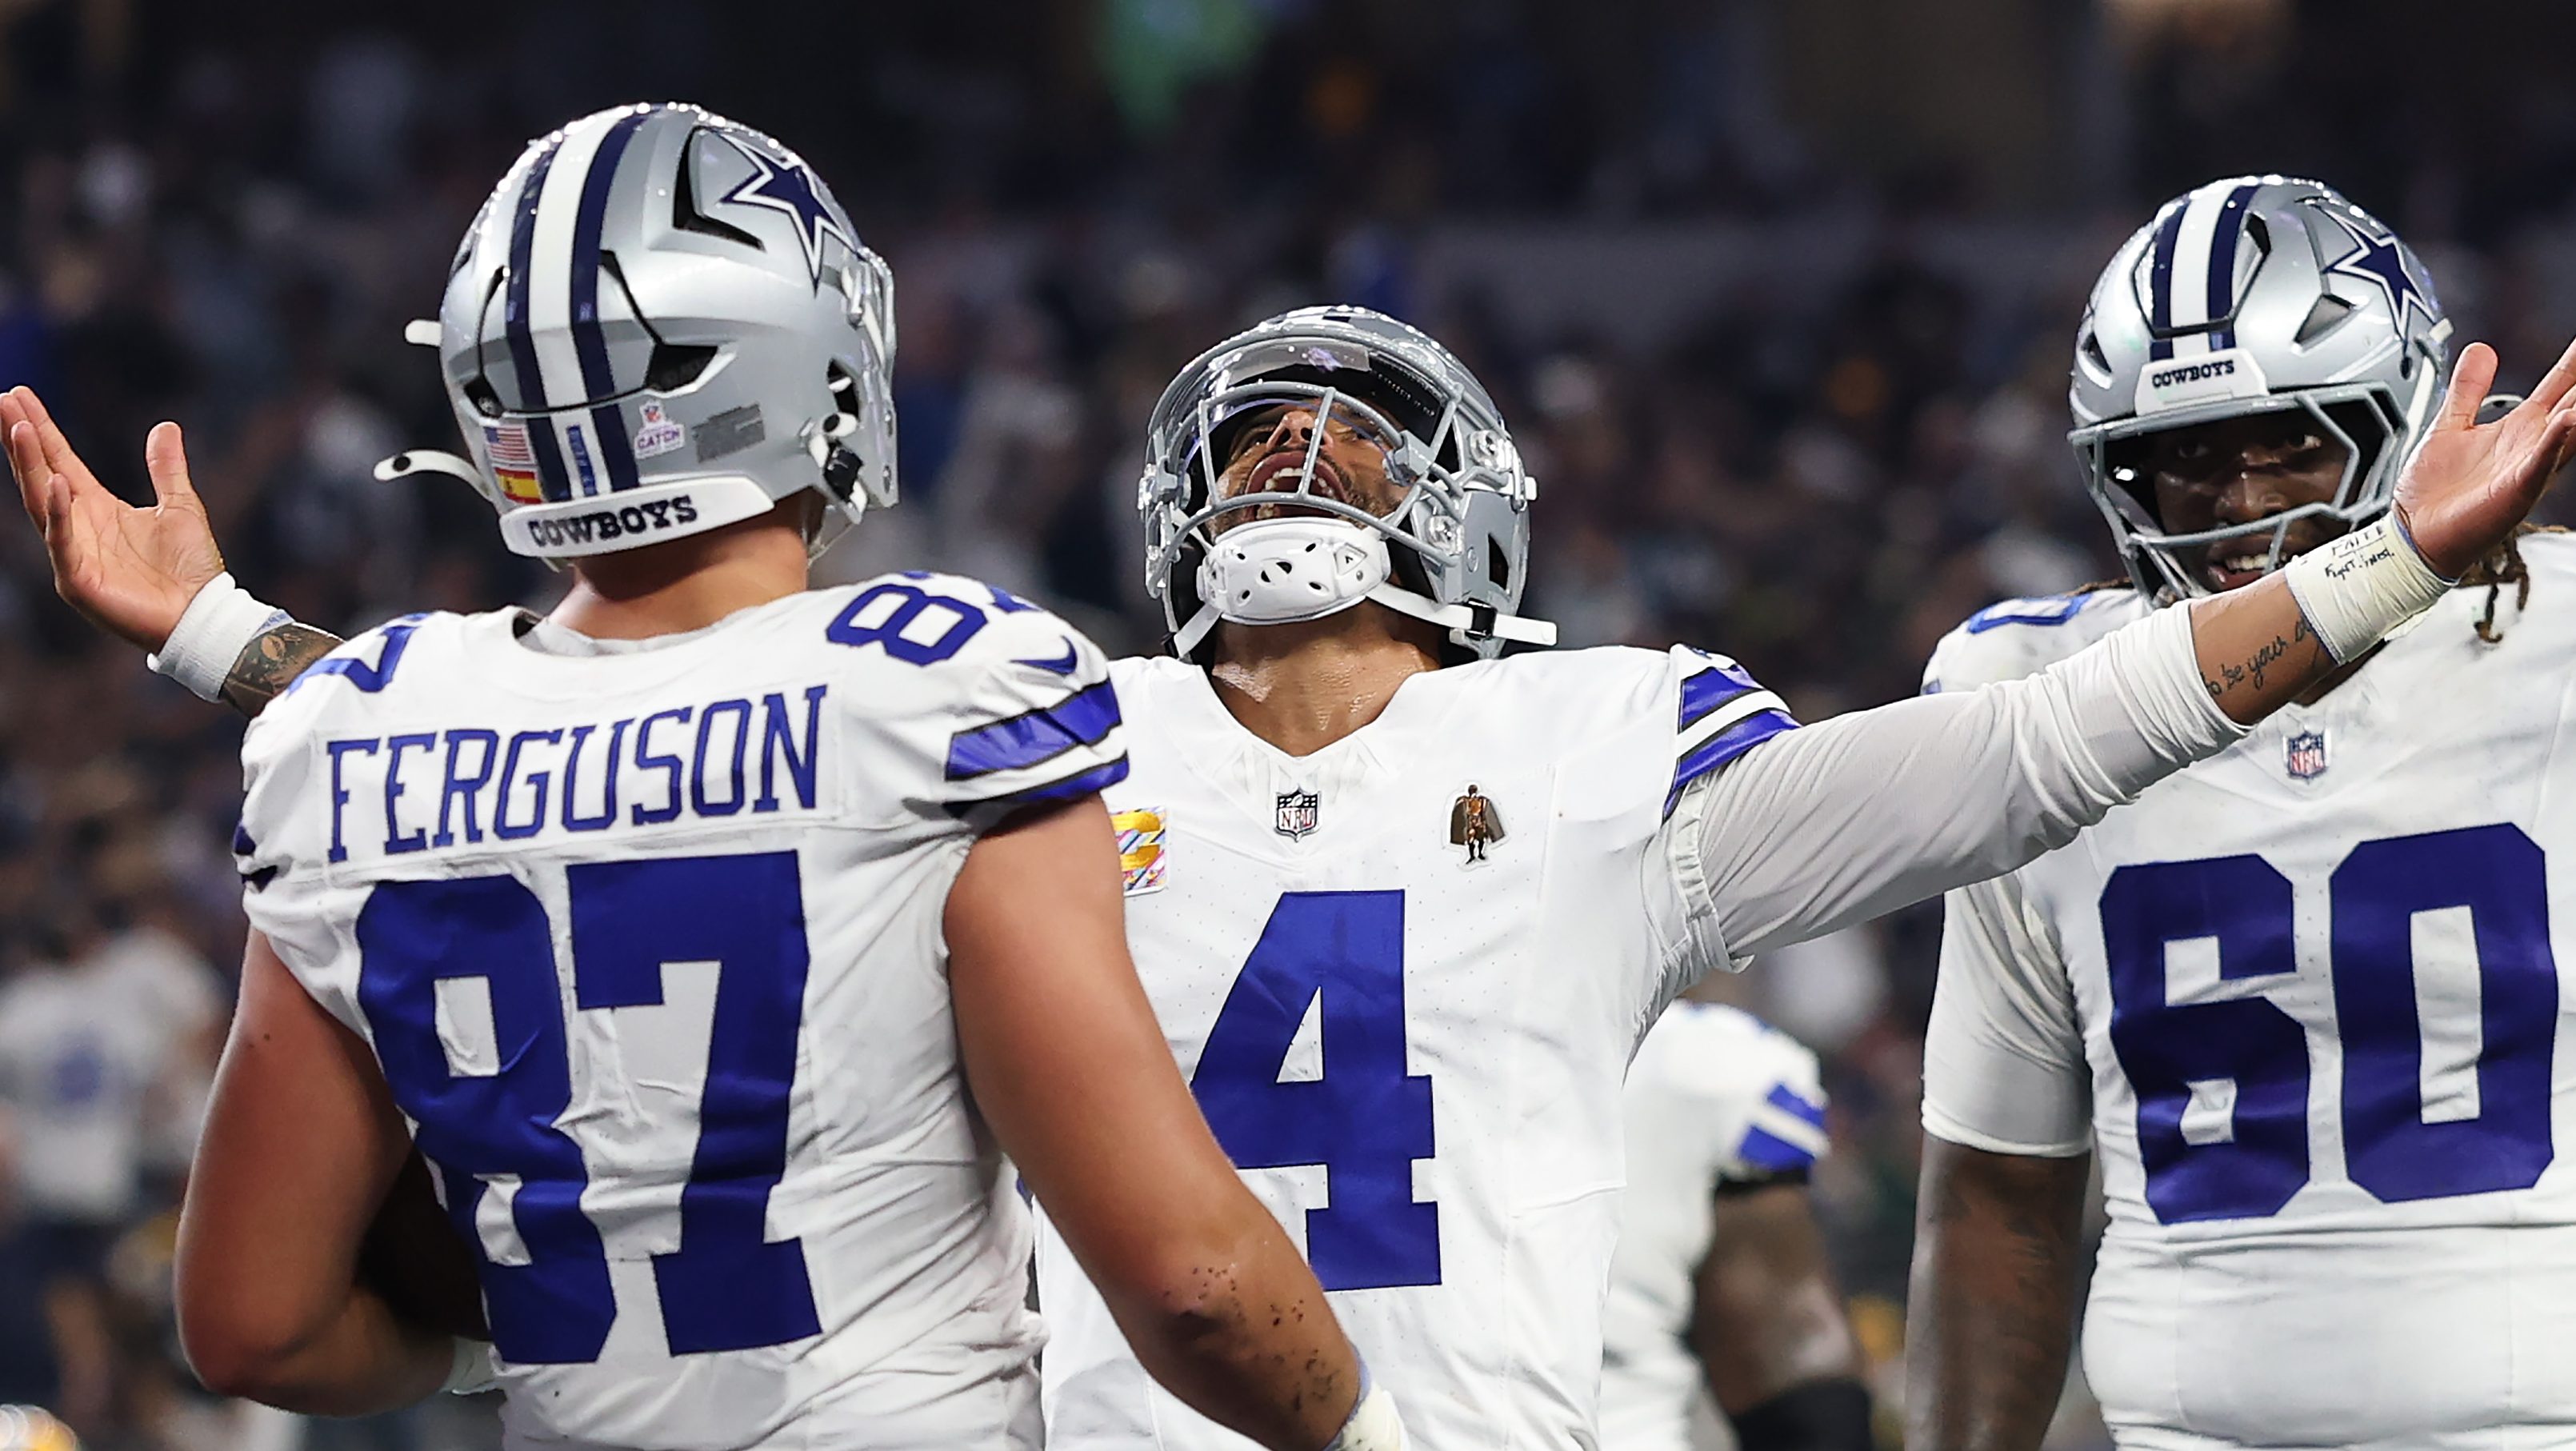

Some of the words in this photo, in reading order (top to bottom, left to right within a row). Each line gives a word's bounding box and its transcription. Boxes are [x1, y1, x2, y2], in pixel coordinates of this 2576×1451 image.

[2151, 359, 2234, 388] COWBOYS
[526, 494, 698, 548] COWBOYS
[327, 684, 827, 864] FERGUSON
[1280, 808, 1314, 829] NFL
[2290, 749, 2324, 773] NFL
[2098, 821, 2559, 1226] 60
[356, 849, 823, 1364] 87
[1189, 889, 1442, 1292] 4
